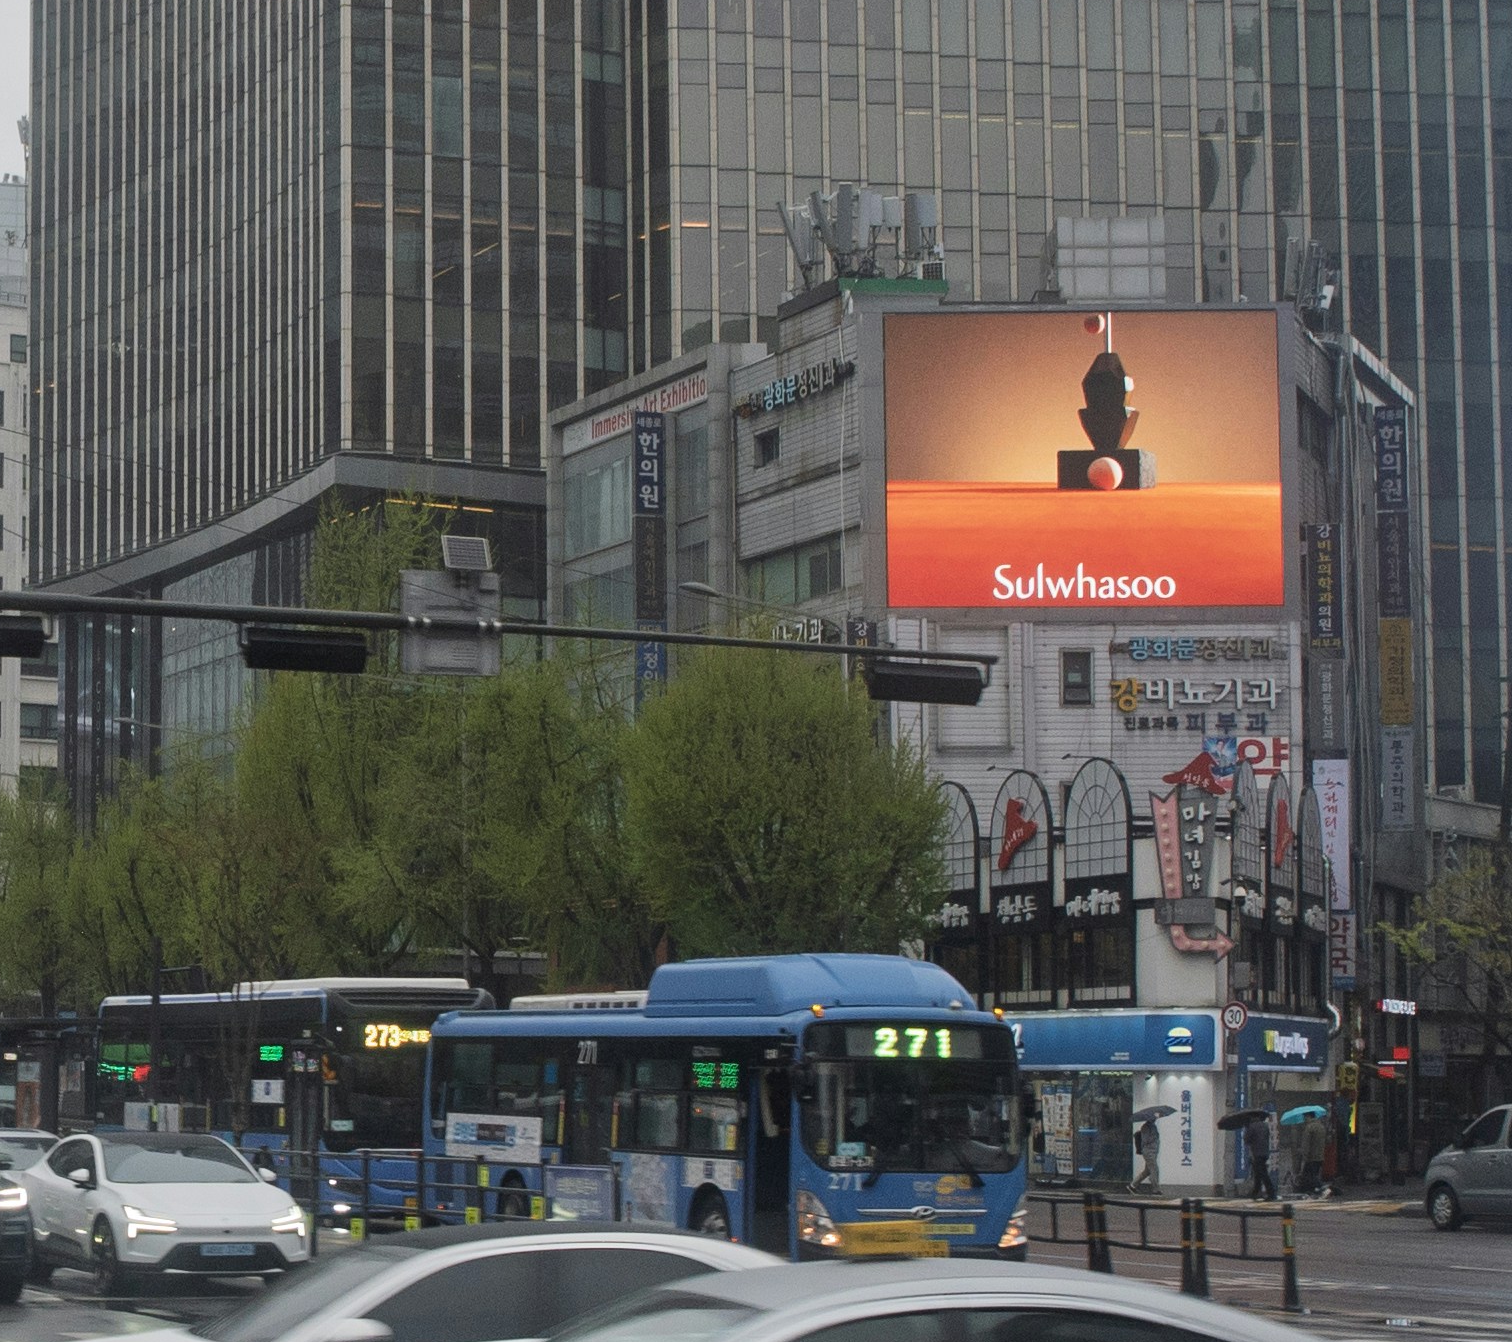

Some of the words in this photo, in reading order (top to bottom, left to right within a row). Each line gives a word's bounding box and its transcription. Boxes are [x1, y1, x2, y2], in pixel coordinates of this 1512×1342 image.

[637, 432, 660, 509] 한의원
[1379, 425, 1404, 503] 한의원
[993, 563, 1176, 601] Sulwhasoo
[1110, 677, 1283, 712] 강비뇨기과
[1181, 801, 1212, 891] 마녀김밥
[1331, 916, 1350, 974] 약국
[1227, 1010, 1242, 1025] 30
[364, 1023, 401, 1049] 273
[577, 1040, 598, 1065] 271
[874, 1027, 952, 1059] 271
[827, 1173, 863, 1192] 271
